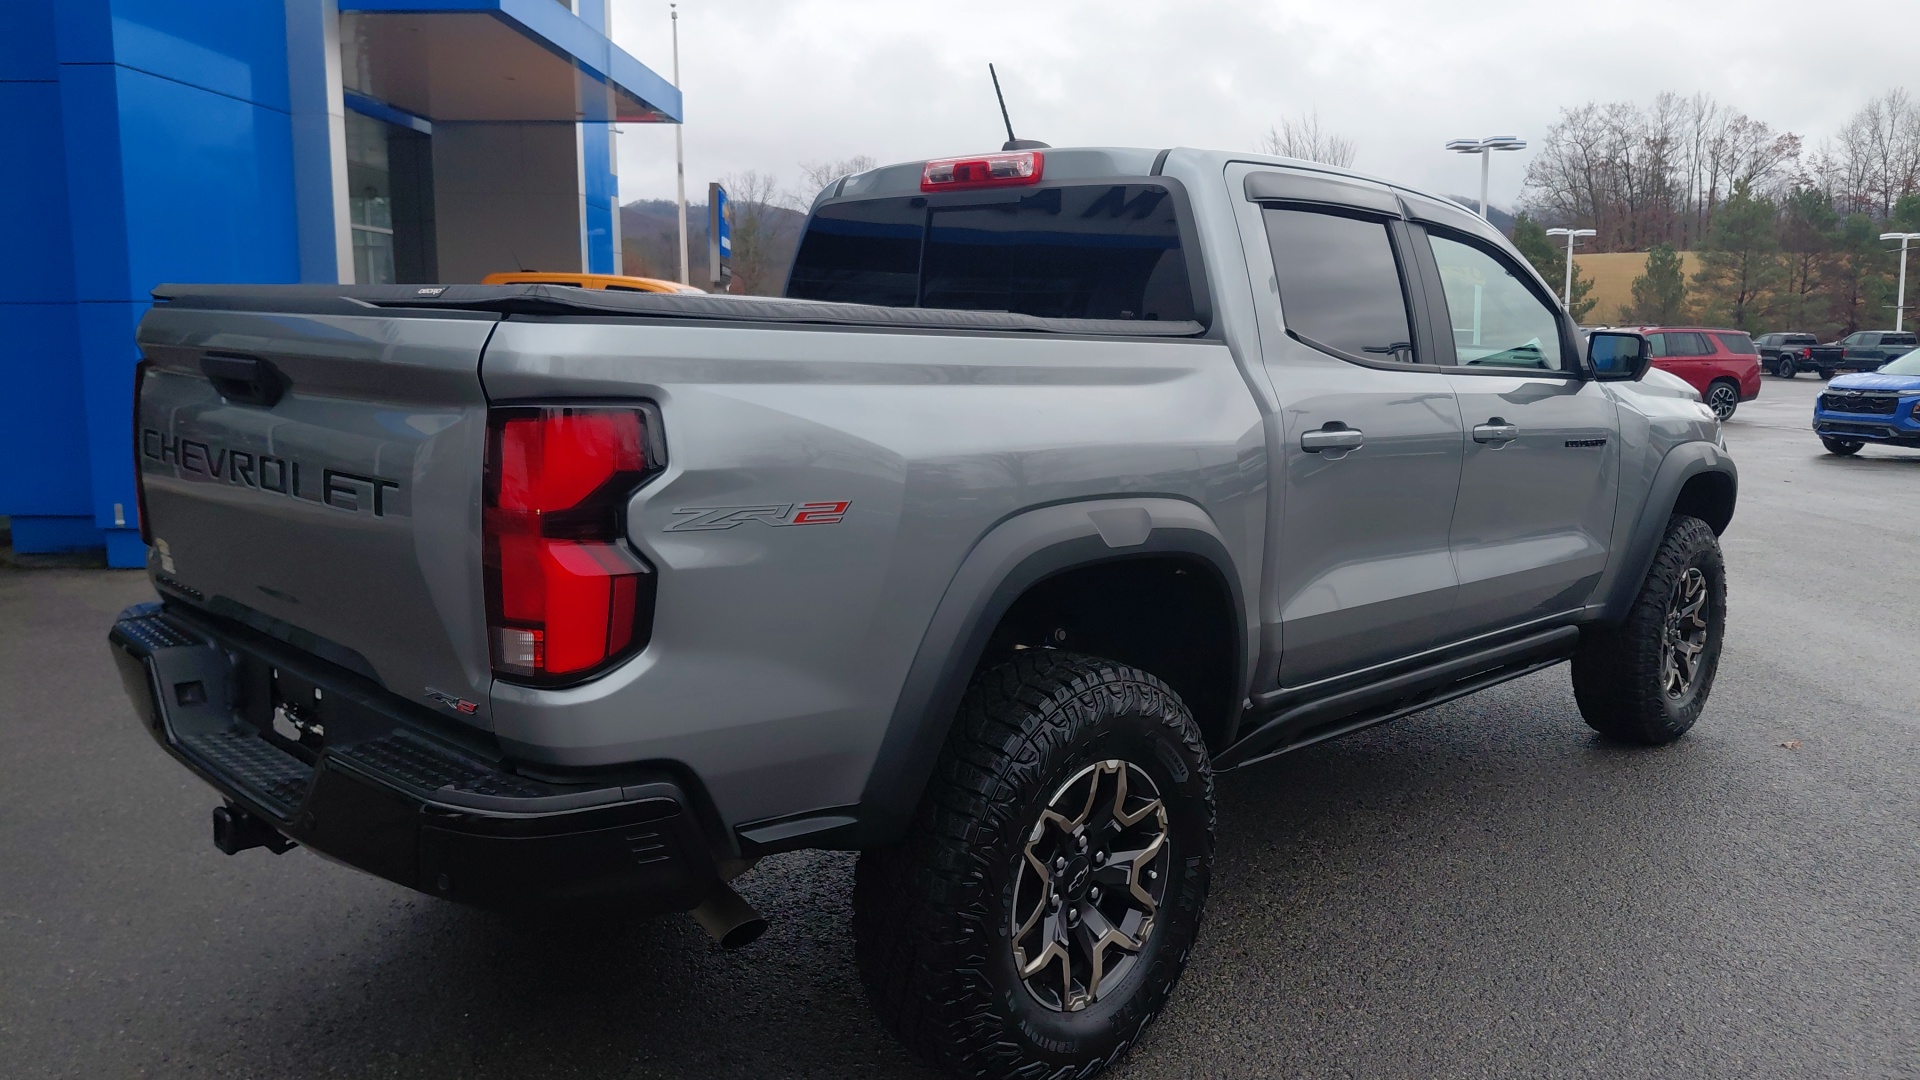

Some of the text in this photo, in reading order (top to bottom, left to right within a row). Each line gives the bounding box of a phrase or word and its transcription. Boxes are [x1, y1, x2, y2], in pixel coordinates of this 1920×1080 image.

[144, 429, 400, 520] CHEVROLET
[662, 500, 853, 532] ZR2
[424, 687, 479, 714] ZR2
